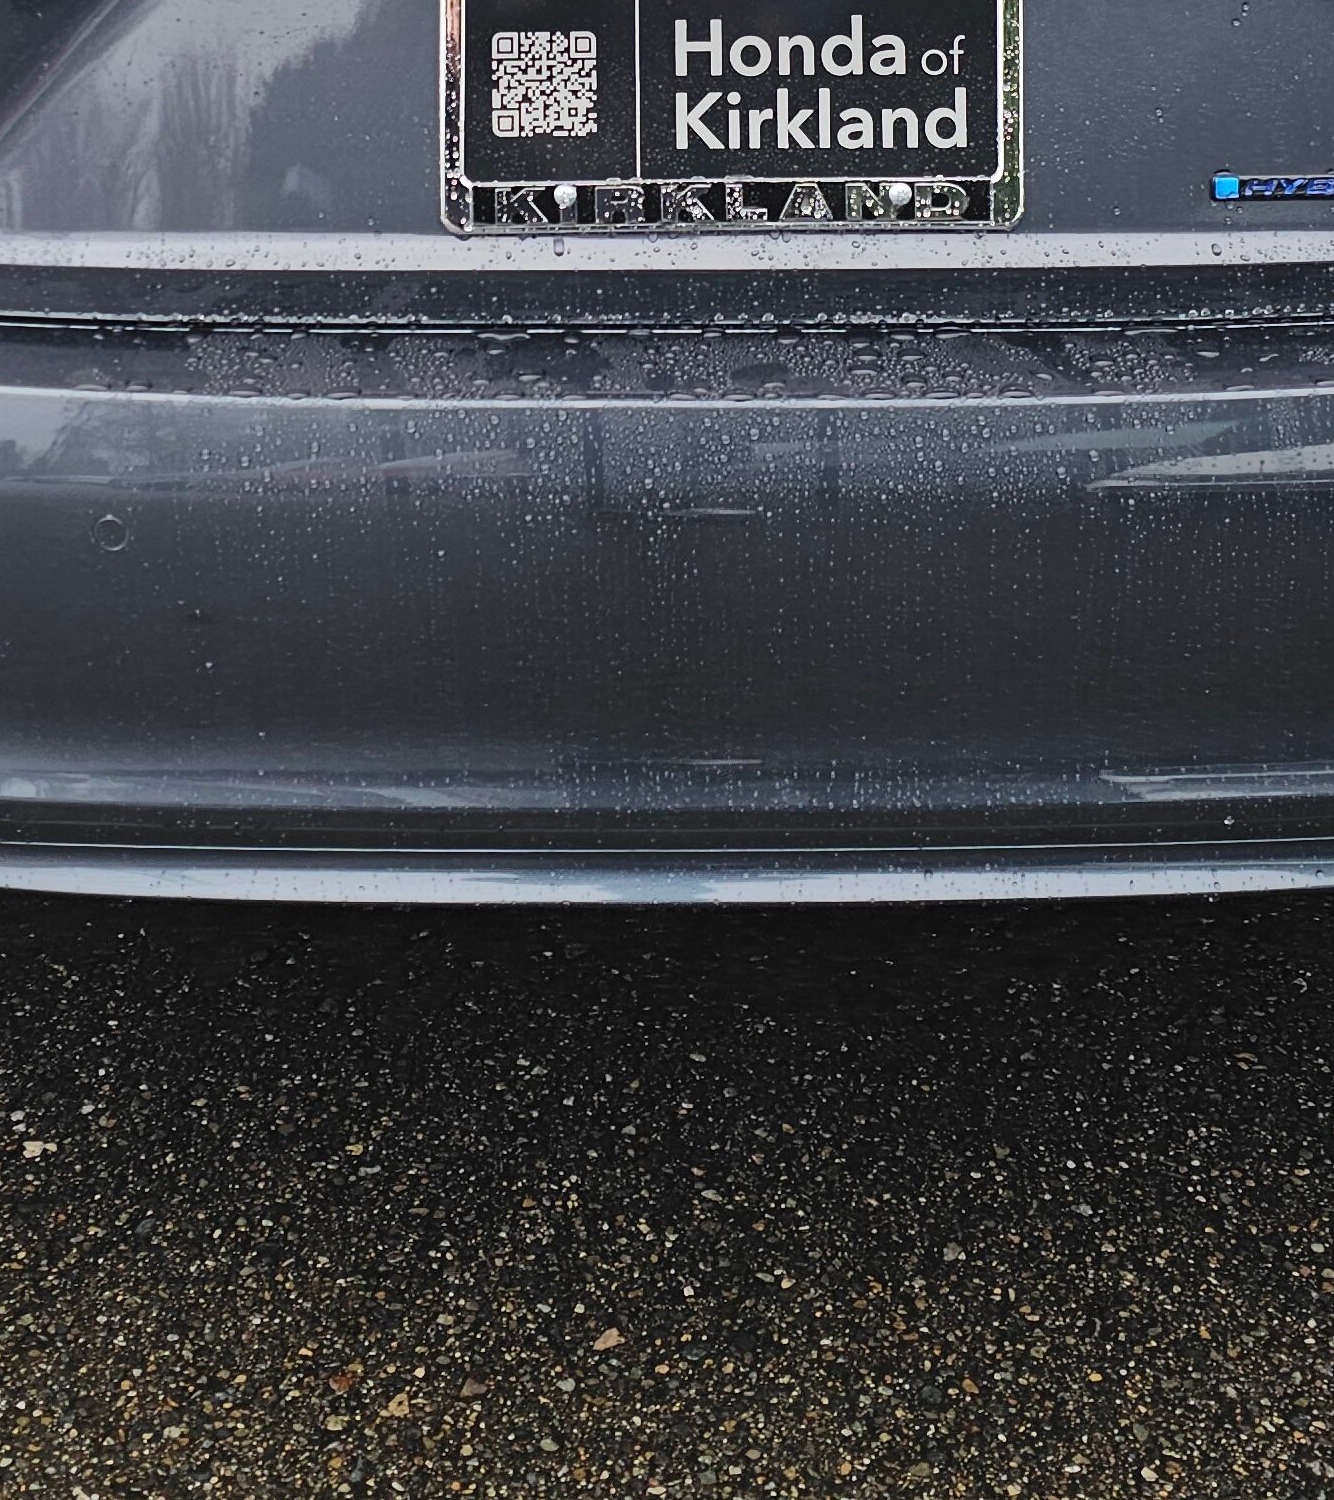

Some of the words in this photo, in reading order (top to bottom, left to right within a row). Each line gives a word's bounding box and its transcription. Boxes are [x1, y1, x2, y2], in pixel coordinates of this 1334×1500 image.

[674, 14, 907, 77] Honda
[921, 35, 966, 76] of
[674, 88, 968, 151] Kirkland
